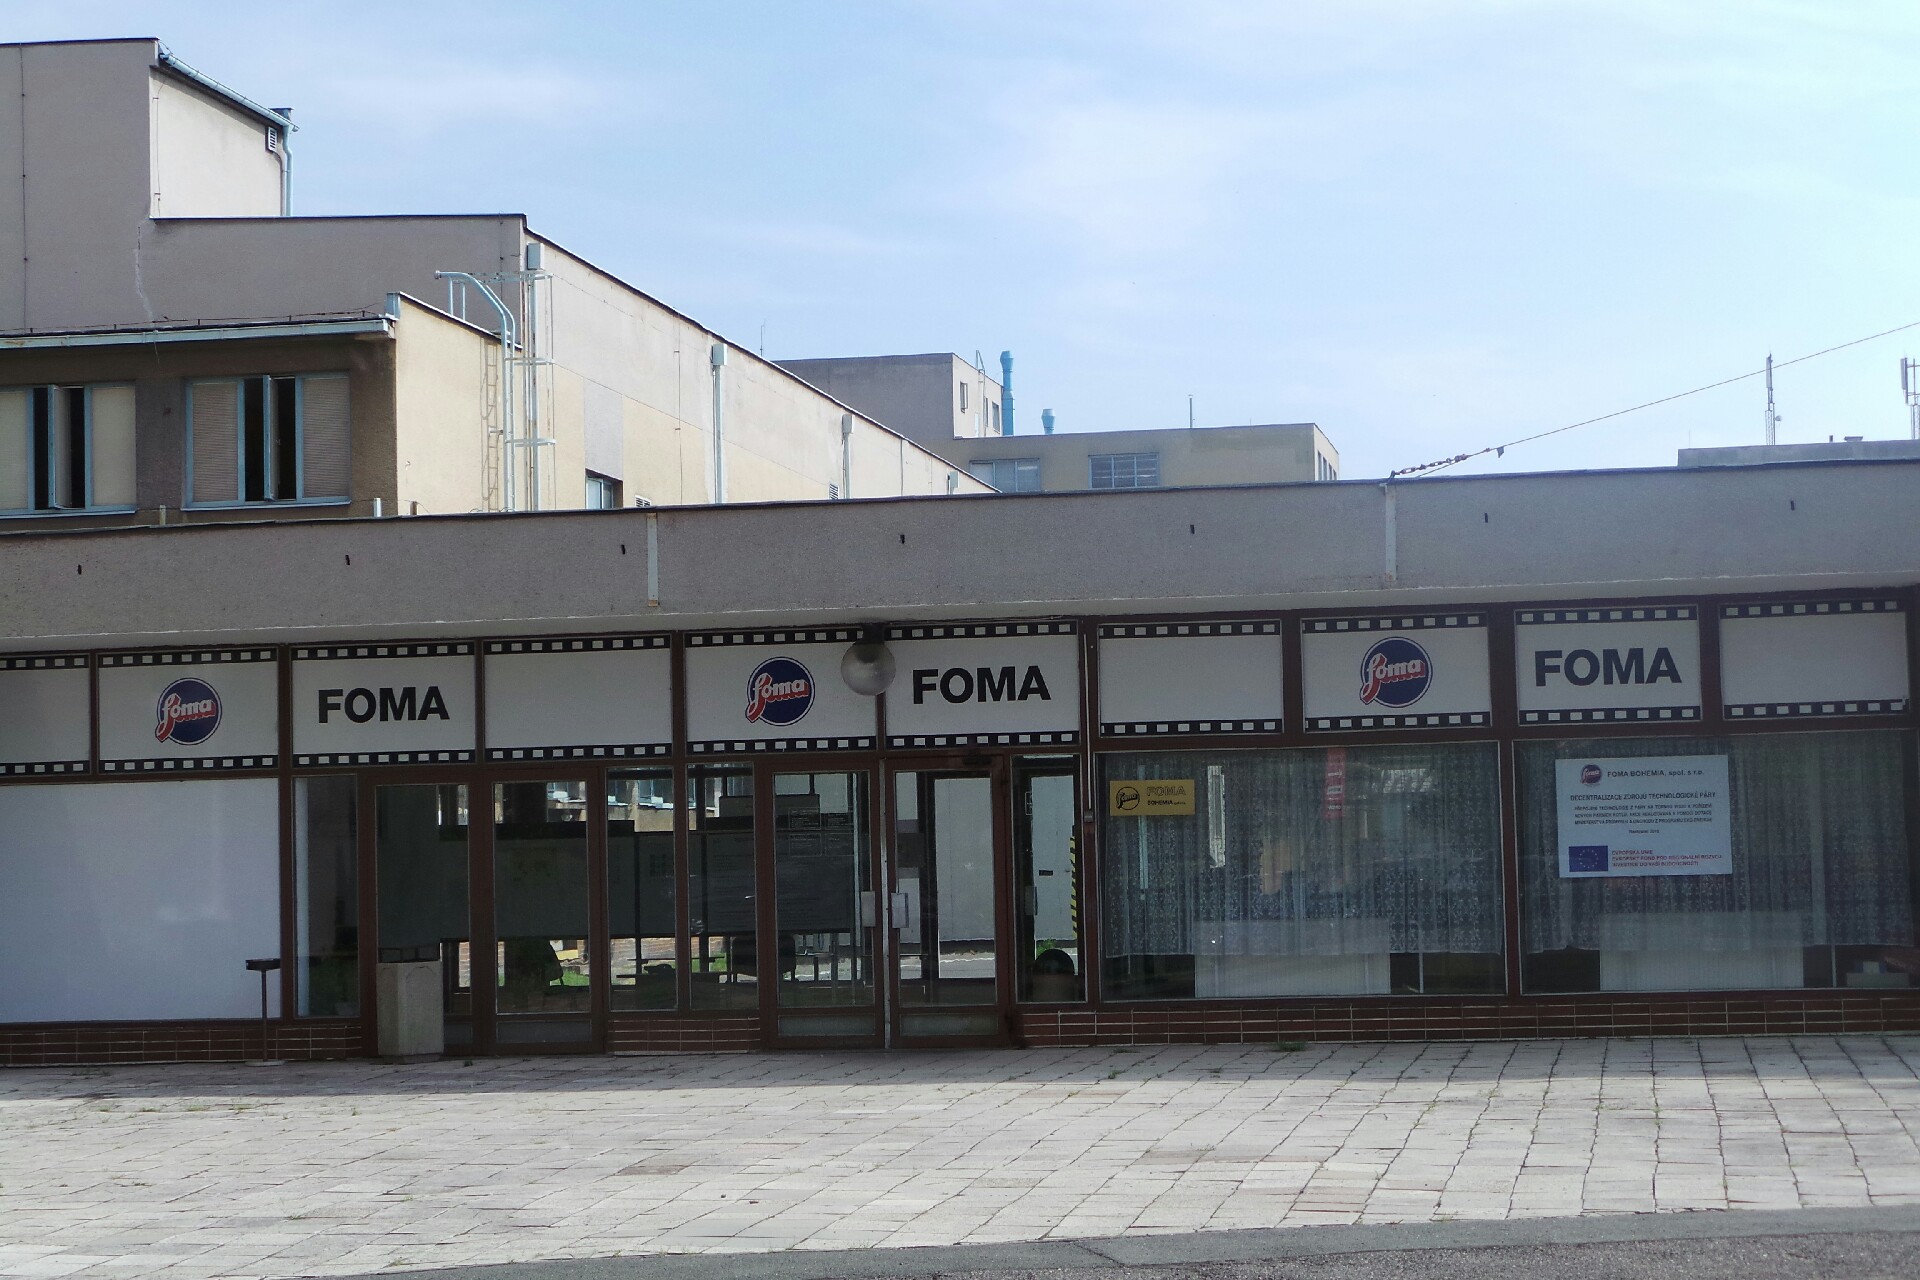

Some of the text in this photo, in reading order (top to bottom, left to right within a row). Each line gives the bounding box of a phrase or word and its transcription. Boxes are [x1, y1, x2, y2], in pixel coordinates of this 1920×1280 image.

[912, 665, 1051, 704] FOMA
[1361, 653, 1426, 704] foma
[1534, 647, 1682, 686] FOMA
[318, 685, 450, 723] FOMA
[747, 672, 809, 722] foma
[156, 692, 217, 742] foma
[1147, 785, 1187, 797] FOMA
[1607, 770, 1629, 778] FOMA
